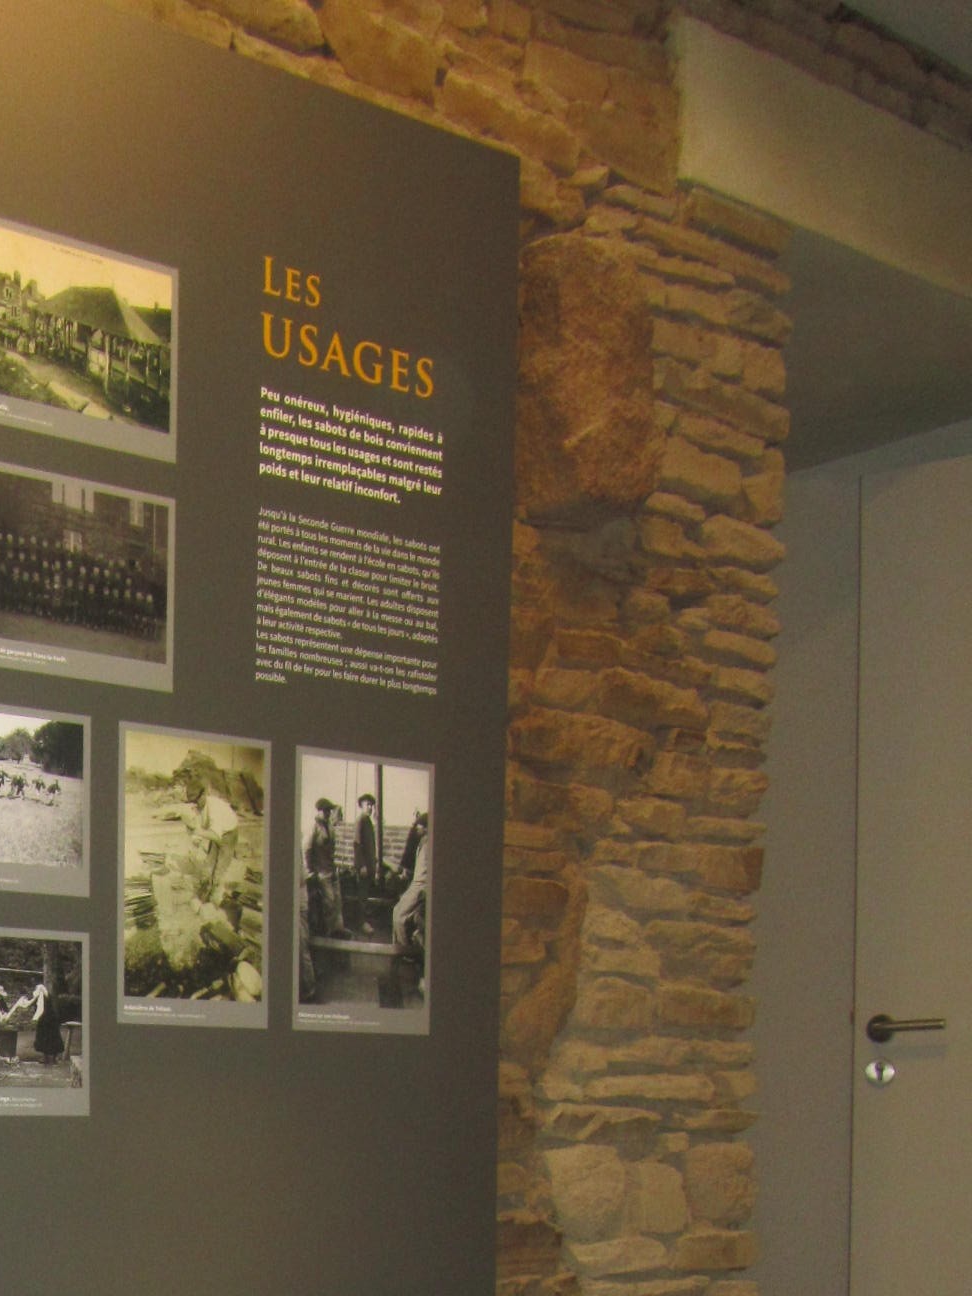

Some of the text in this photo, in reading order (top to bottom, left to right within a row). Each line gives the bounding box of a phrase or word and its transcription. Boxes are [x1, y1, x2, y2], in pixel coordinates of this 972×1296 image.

[262, 255, 320, 308] LES
[260, 312, 434, 398] USAGES
[259, 406, 443, 461] enfiler, les sabots de bois conviennent
[260, 385, 443, 444] Peu onéreux, hygiéniques, rapides à
[258, 441, 442, 495] longtemps irremplaçables malgré leur
[259, 421, 442, 478] à presque tous les usages et sont restés
[258, 462, 401, 503] poids et leur relatif inconfort.
